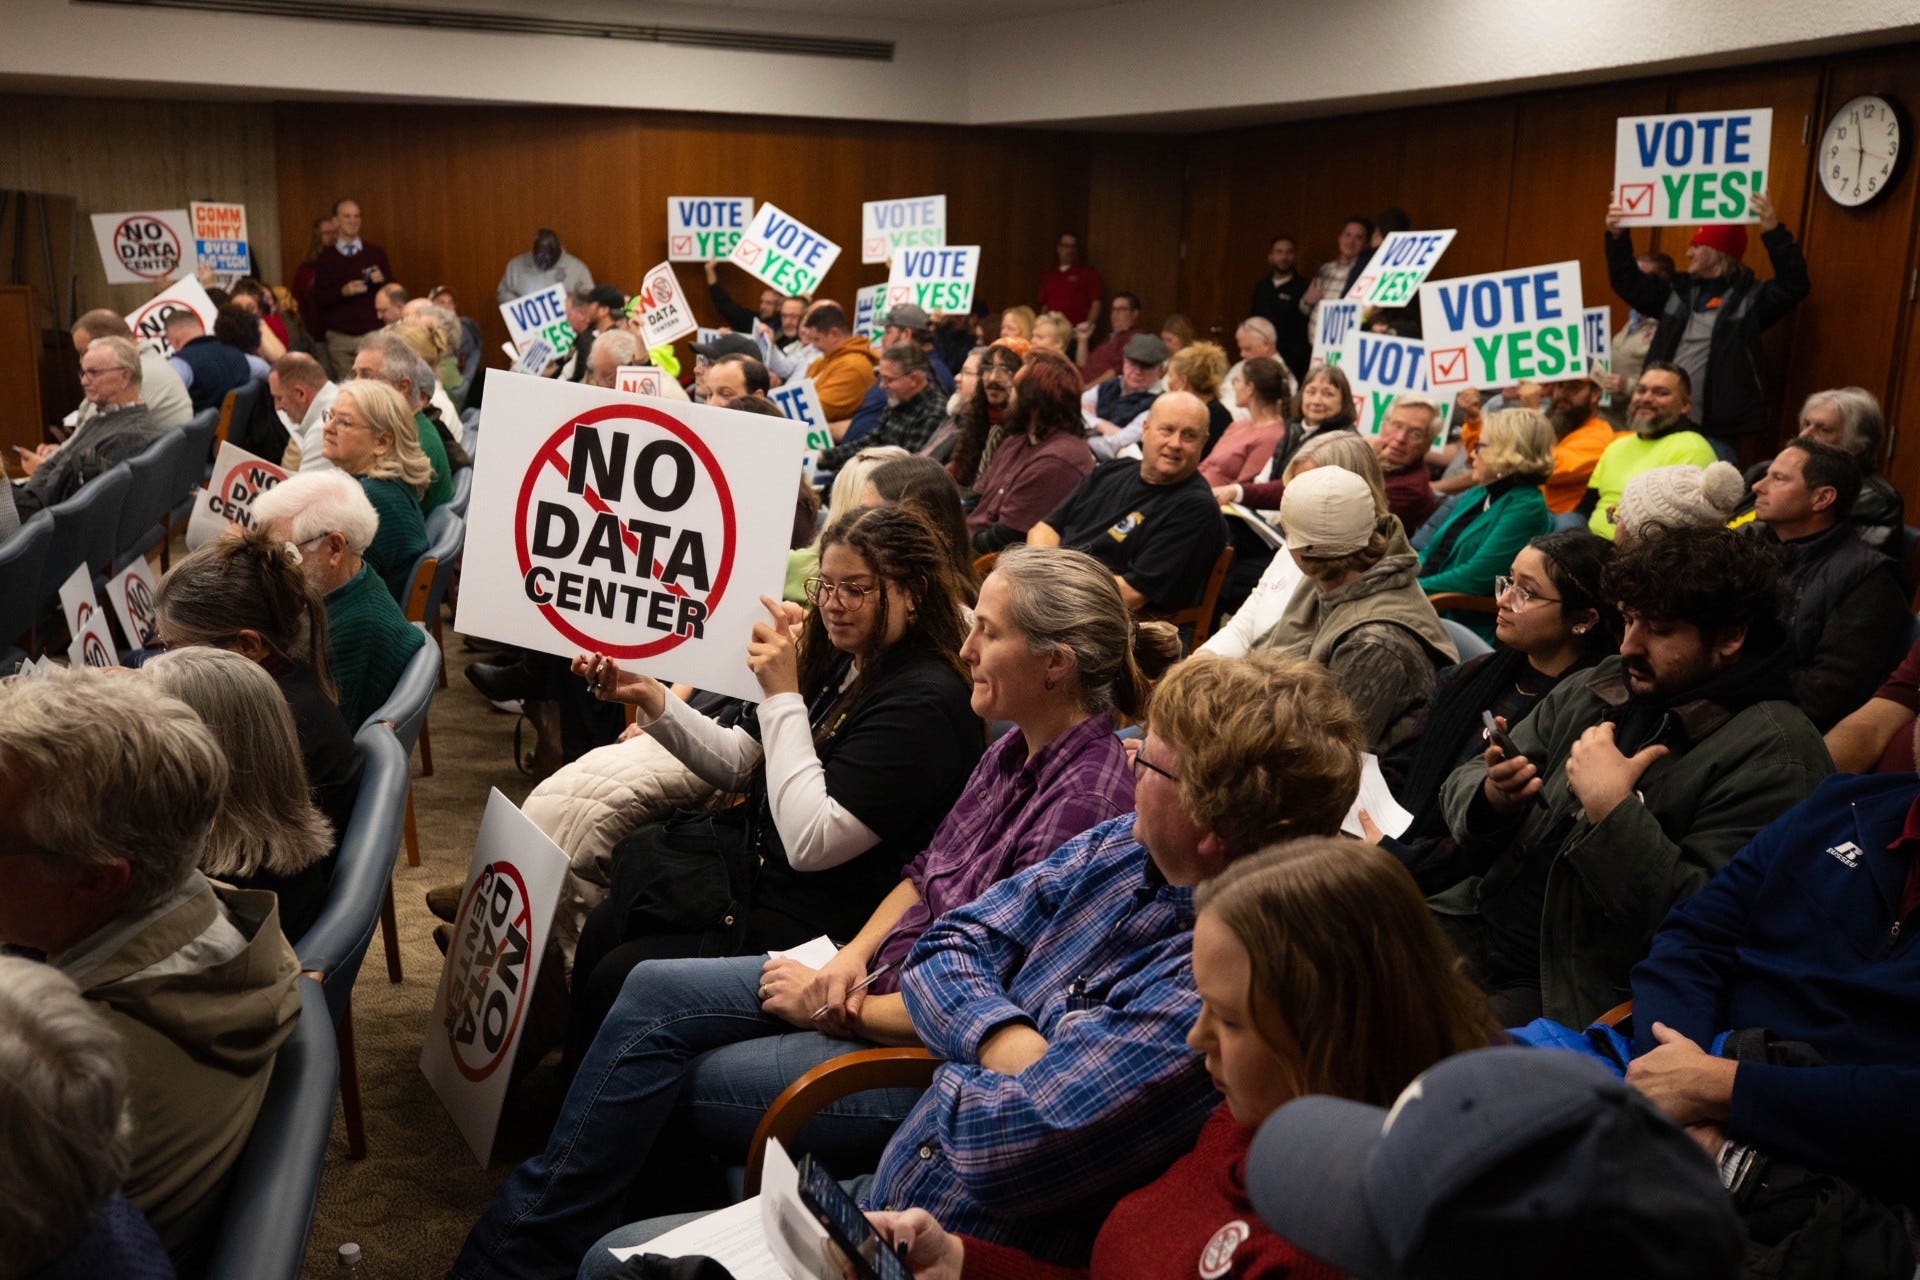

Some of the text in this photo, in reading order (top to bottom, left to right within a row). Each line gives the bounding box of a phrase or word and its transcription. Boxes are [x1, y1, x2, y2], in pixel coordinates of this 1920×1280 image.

[1850, 111, 1859, 125] 11
[1863, 104, 1875, 119] 12
[1880, 108, 1885, 121] 1
[1636, 116, 1752, 168] VOTE
[1887, 122, 1896, 136] 2
[1831, 145, 1839, 159] 9
[1888, 141, 1897, 156] 3
[1832, 165, 1841, 180] 8
[1880, 163, 1889, 176] 4
[1661, 170, 1763, 220] YES!
[1840, 177, 1849, 192] 7
[1853, 184, 1861, 197] 6
[1868, 177, 1876, 192] 5
[196, 206, 241, 223] COMM
[679, 201, 742, 228] VOTE
[874, 201, 935, 229] VOTE
[124, 222, 162, 240] NO
[197, 225, 241, 240] UNITY
[763, 212, 828, 268] VOTE
[121, 242, 176, 260] DATA
[203, 242, 238, 255] OVER
[1382, 235, 1444, 266] VOTE
[124, 257, 180, 271] CENTER
[760, 248, 817, 297] YES!
[904, 251, 967, 278] VOTE
[916, 282, 971, 310] YES!
[1369, 271, 1425, 302] YES!
[510, 290, 565, 331] VOTE
[648, 304, 677, 326] DATA
[1438, 271, 1562, 332] VOTE
[1322, 305, 1356, 345] VOTE
[1358, 338, 1428, 392] VOT
[1472, 324, 1582, 383] YES!
[567, 424, 696, 512] NO
[531, 500, 710, 592] DATA
[524, 566, 709, 640] CENTER
[444, 863, 494, 1036] CENTER
[456, 876, 514, 1045] DATA
[483, 922, 529, 1053] NO
